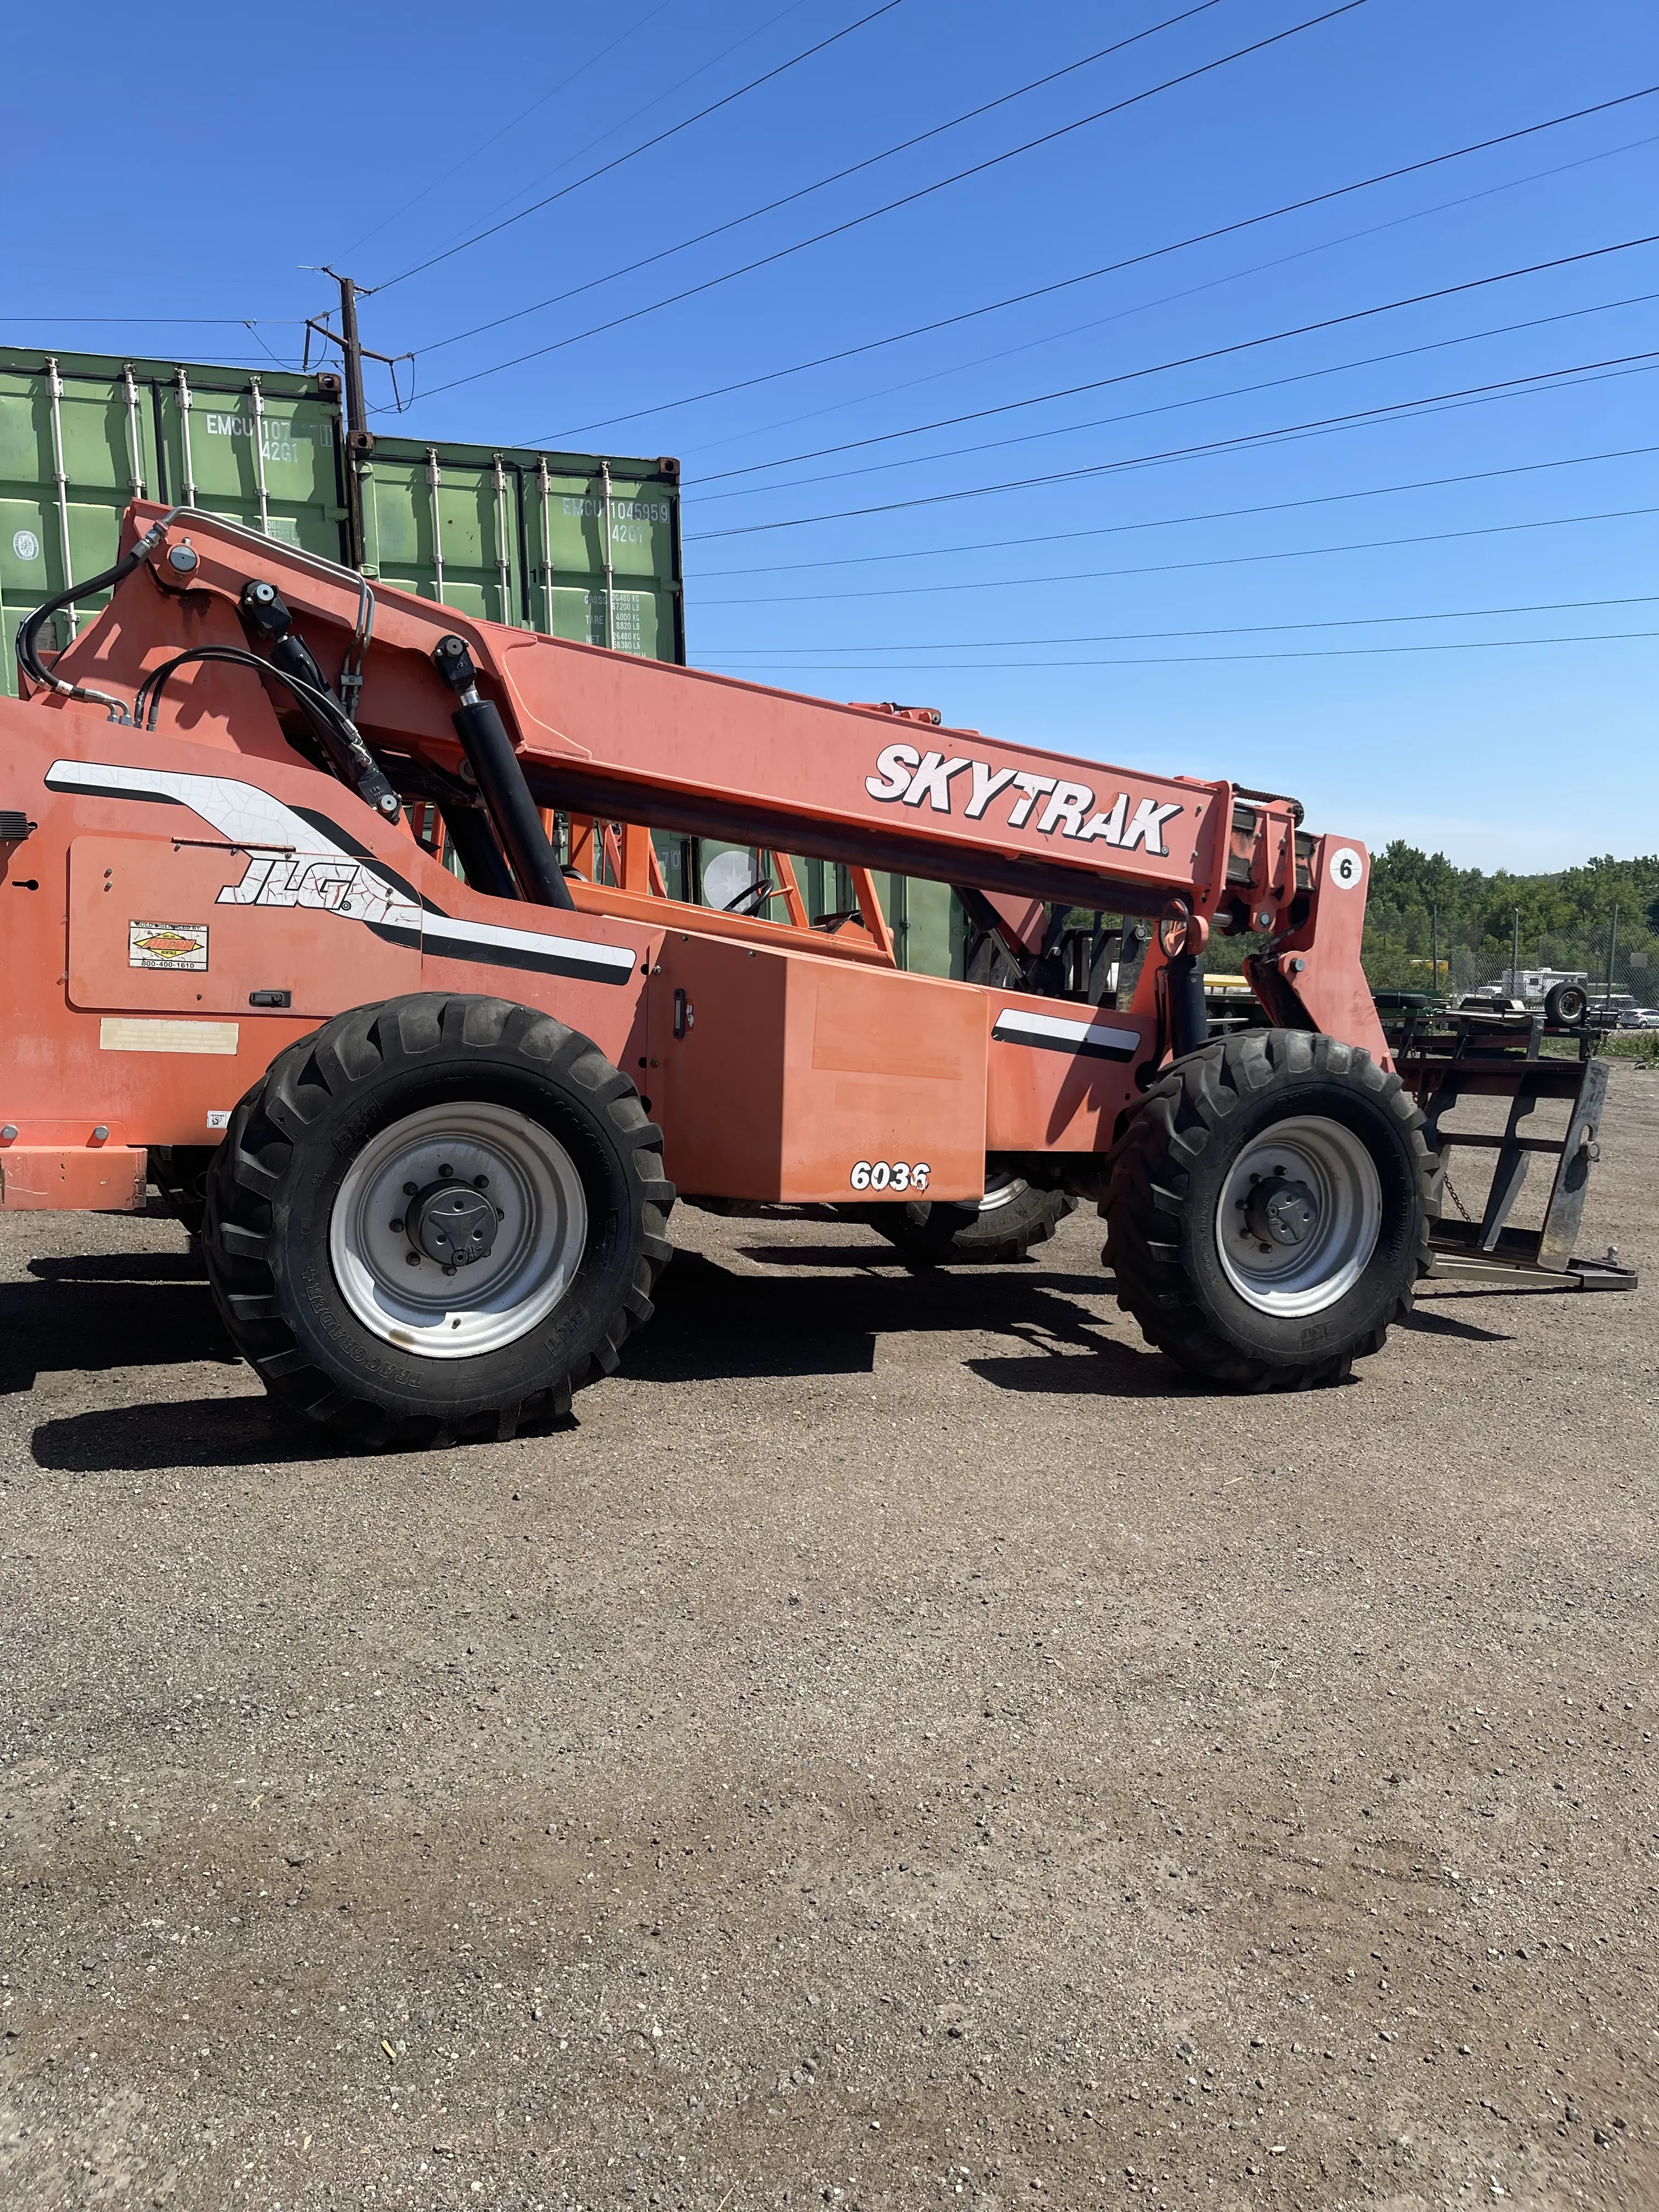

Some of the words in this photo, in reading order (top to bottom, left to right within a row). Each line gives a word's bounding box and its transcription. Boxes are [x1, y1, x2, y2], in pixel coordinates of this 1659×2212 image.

[206, 414, 253, 437] EMCU
[262, 441, 298, 462] 42G1
[563, 498, 602, 517] EMCU
[530, 569, 537, 583] 1
[584, 595, 607, 605] GROSS
[585, 615, 603, 625] TARE
[586, 634, 600, 644] NET
[633, 633, 640, 641] KG
[633, 641, 640, 650] LB
[865, 743, 1184, 856] SKYTRAK
[1340, 859, 1352, 879] 6
[214, 857, 360, 911] JLG
[143, 938, 196, 951] AHERN
[850, 1160, 932, 1192] 6036
[306, 1282, 367, 1363] GRADER
[365, 1356, 425, 1389] TRAC
